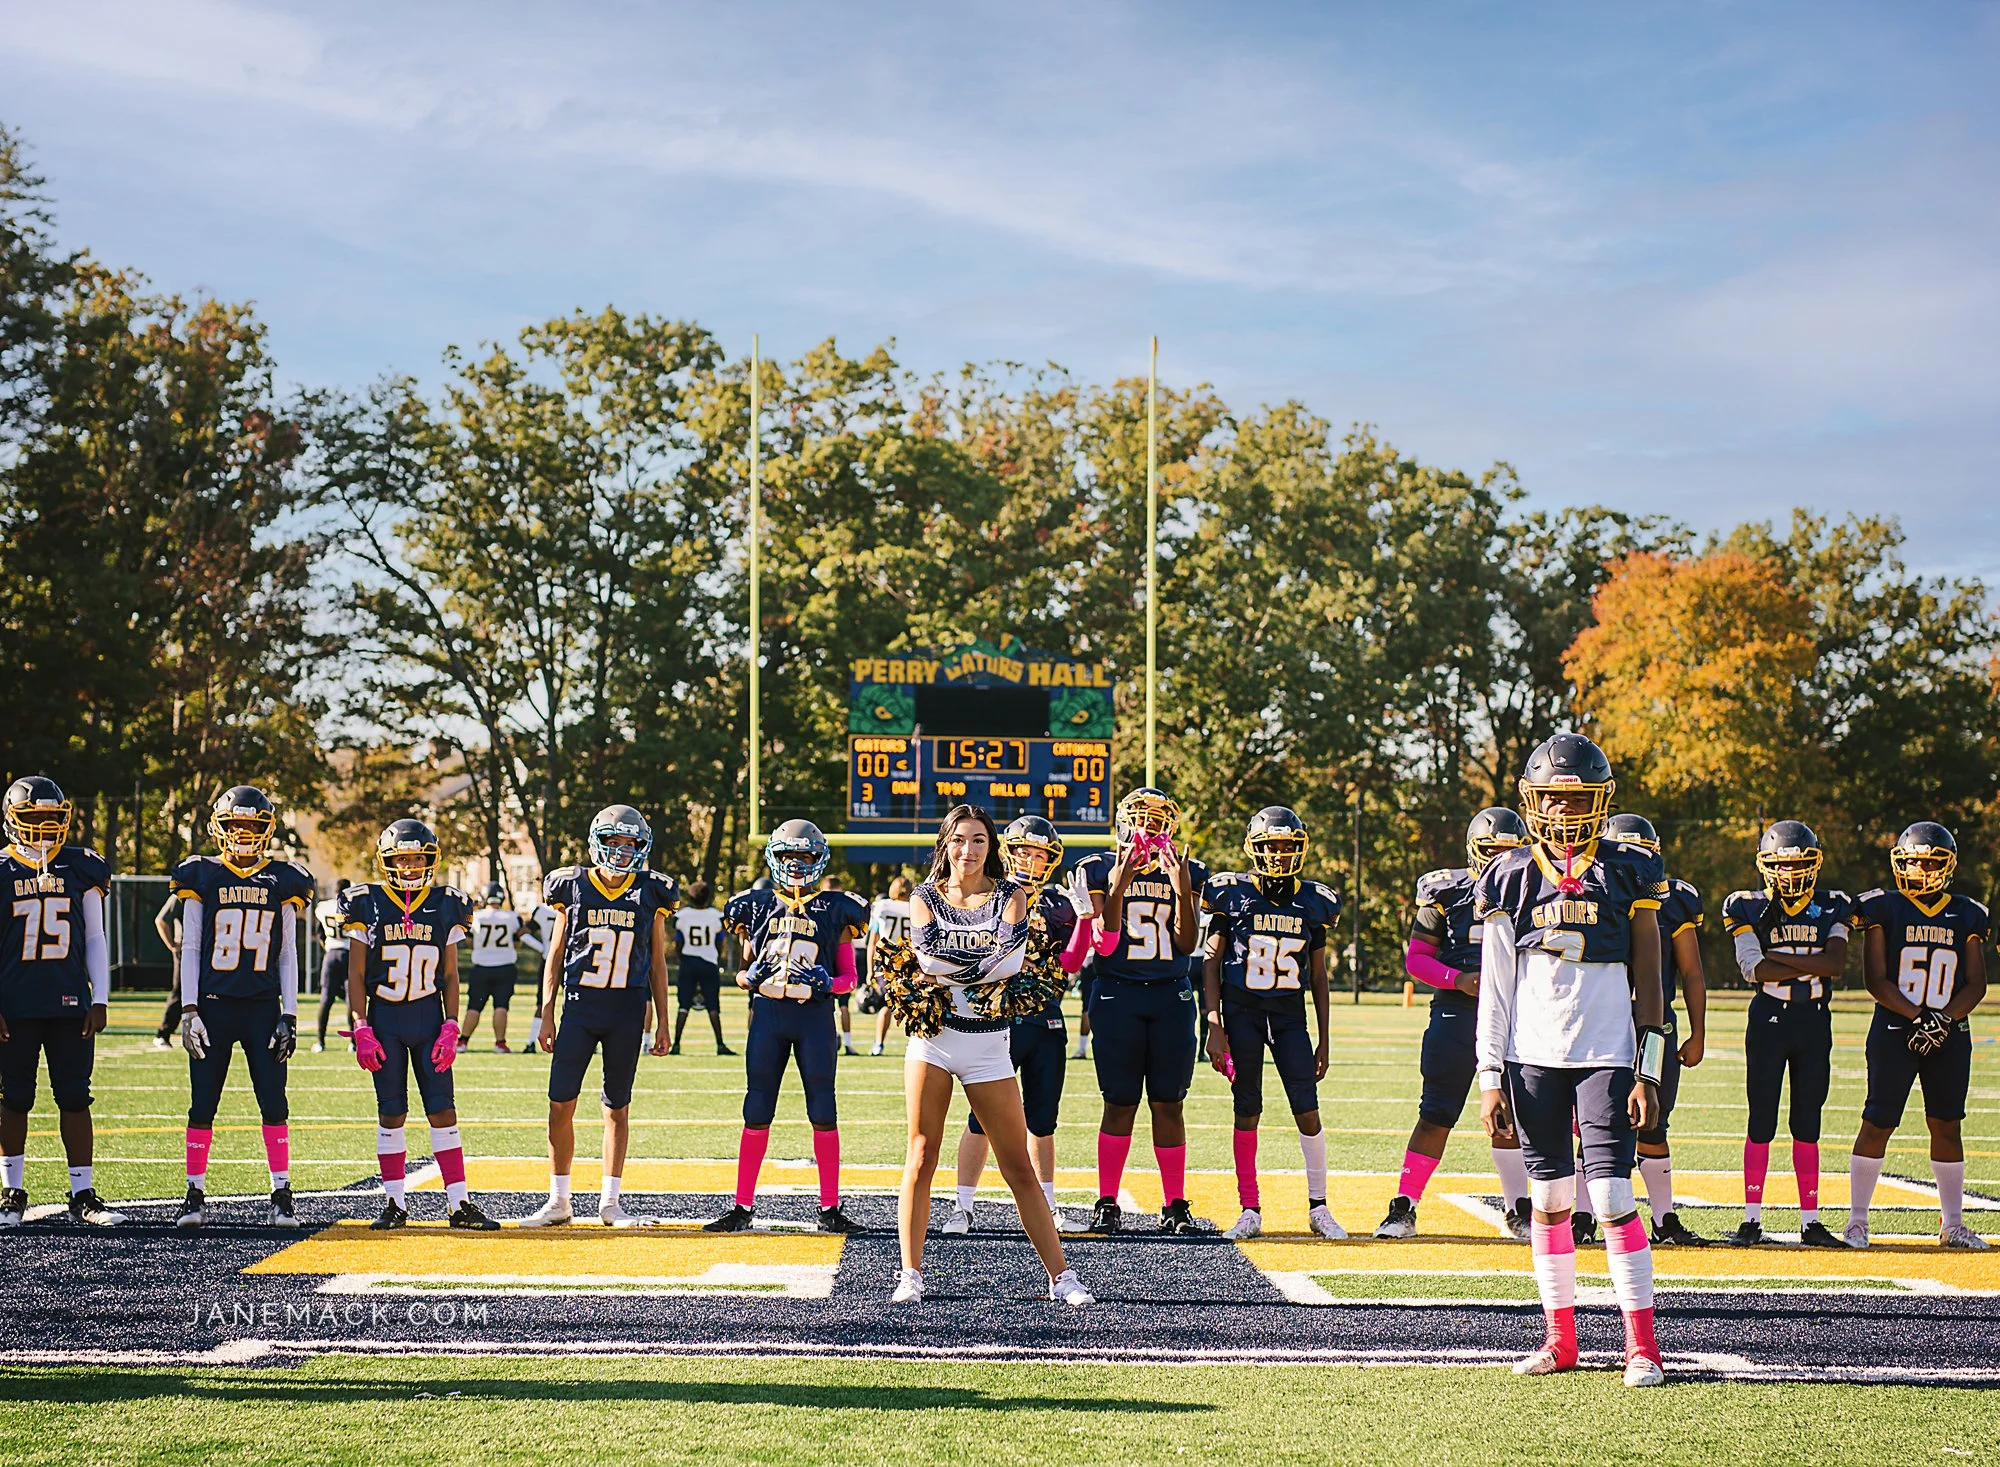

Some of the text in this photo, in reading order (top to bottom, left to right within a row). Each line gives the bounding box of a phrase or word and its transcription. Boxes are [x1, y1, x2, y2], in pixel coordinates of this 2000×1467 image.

[855, 658, 940, 684] PERRY
[1028, 662, 1112, 687] HALL
[854, 738, 907, 753] GATORS
[949, 739, 1025, 769] 15:27
[857, 753, 889, 778] 00
[1073, 757, 1105, 782] 00
[862, 782, 873, 802] 3
[1089, 787, 1101, 807] 3
[14, 877, 65, 896] GATORS
[218, 885, 269, 905] GATORS
[587, 908, 635, 928] GATORS
[1253, 913, 1303, 934] GATORS
[1532, 899, 1599, 928] GATORS
[12, 896, 71, 961] 75
[384, 923, 433, 941] GATORS
[480, 923, 509, 948] 72
[690, 925, 710, 946] 61
[768, 916, 816, 937] GATORS
[1127, 901, 1173, 960] 51
[1905, 925, 1954, 946] GATORS
[211, 908, 276, 971] 84
[579, 928, 635, 989] 31
[1245, 934, 1307, 990] 85
[375, 944, 440, 1002] 30
[1898, 946, 1958, 1010] 60
